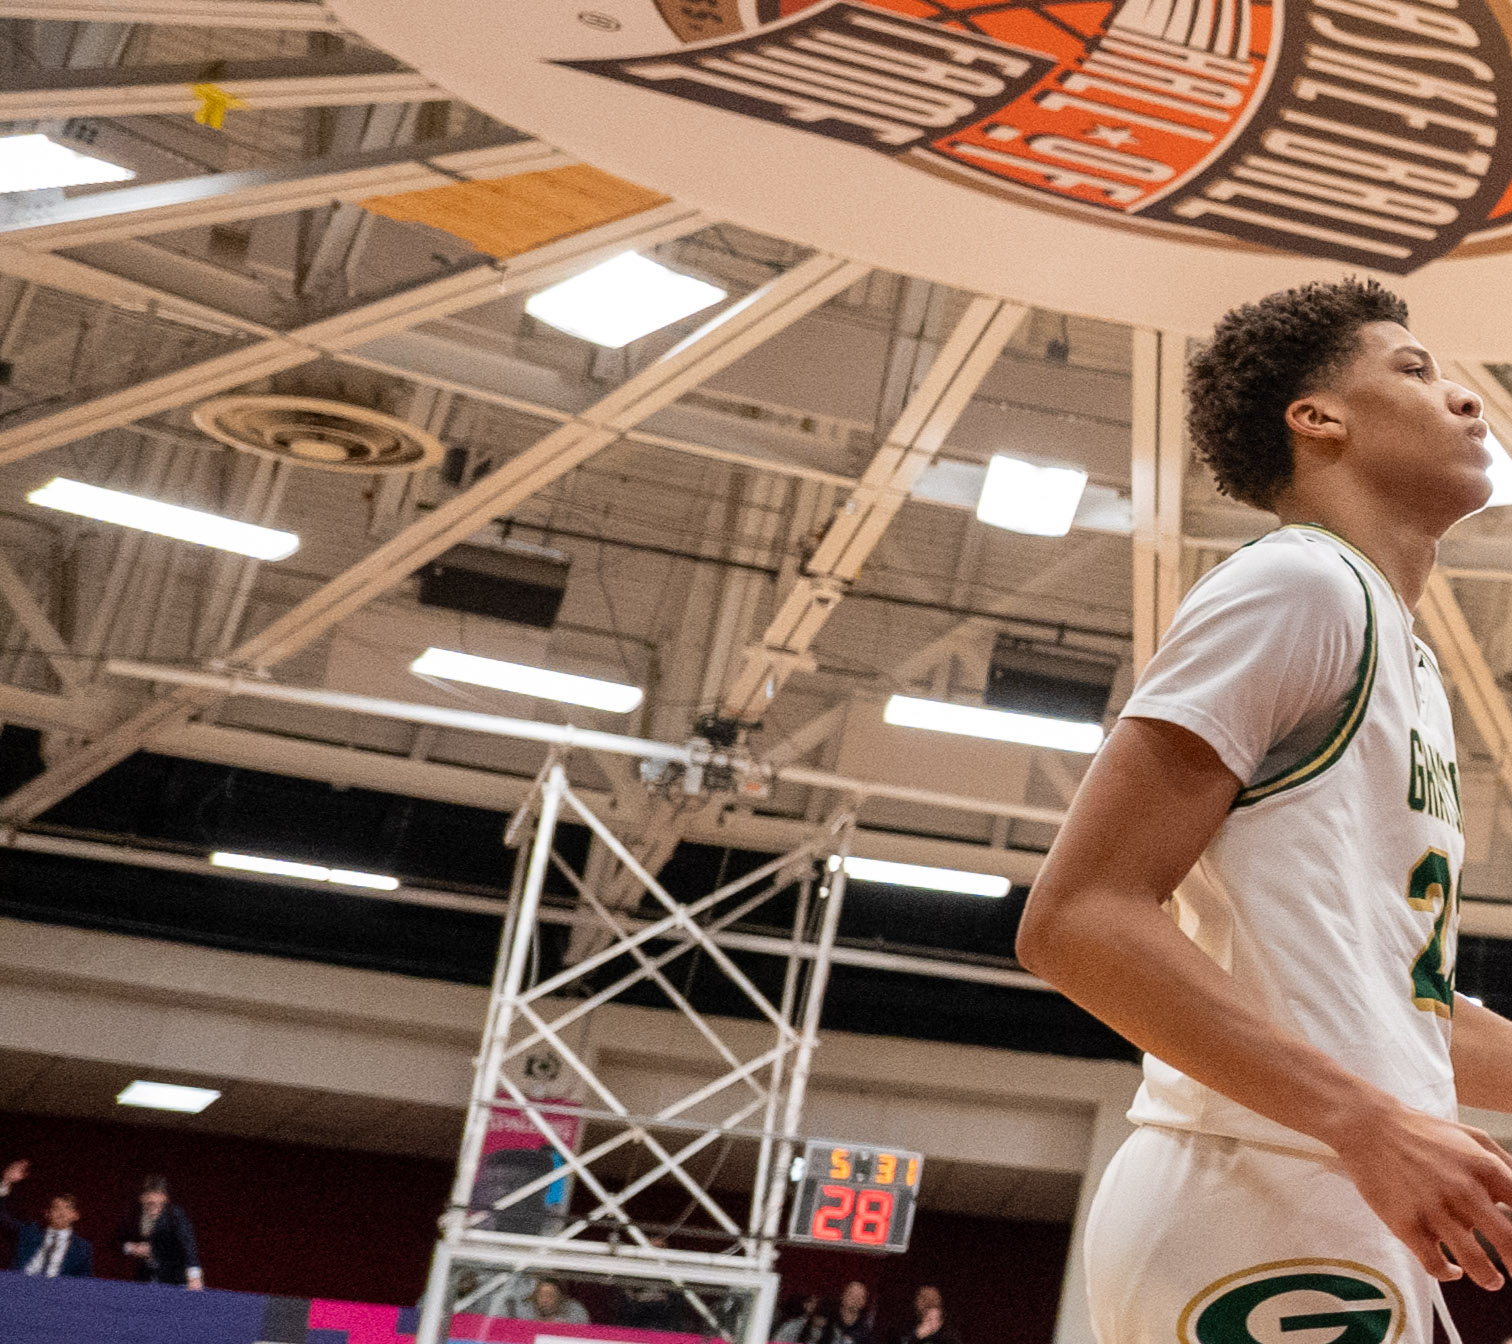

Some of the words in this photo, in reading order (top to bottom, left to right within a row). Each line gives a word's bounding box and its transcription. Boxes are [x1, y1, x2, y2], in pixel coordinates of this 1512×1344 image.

[620, 11, 1032, 148] FAME
[1036, 24, 1255, 143] HALL
[811, 1184, 895, 1246] 28
